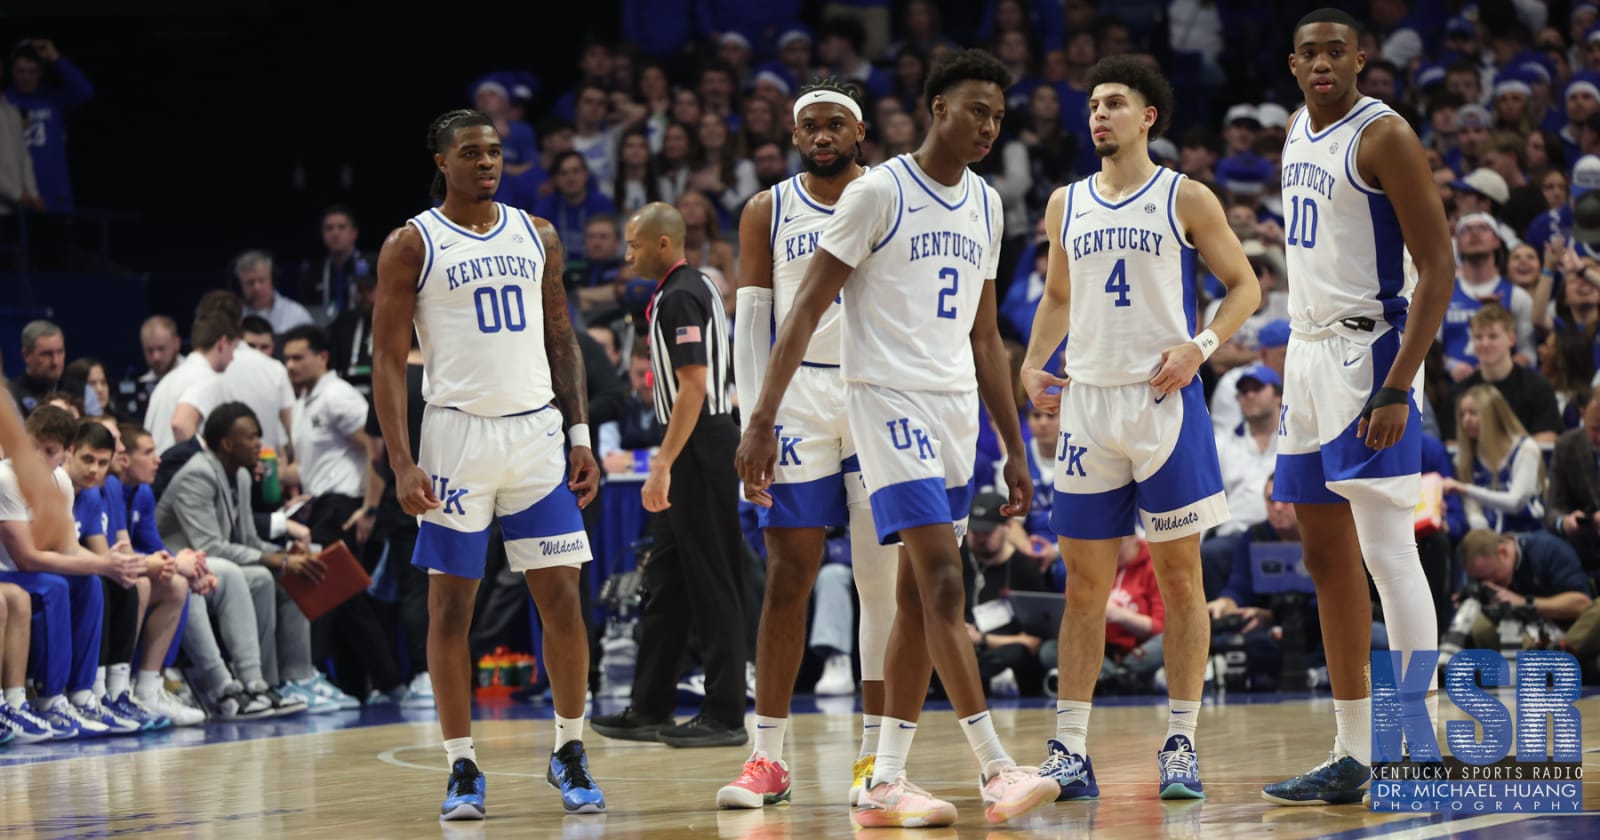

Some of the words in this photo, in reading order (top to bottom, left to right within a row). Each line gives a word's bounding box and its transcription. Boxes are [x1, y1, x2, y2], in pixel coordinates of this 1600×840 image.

[1282, 162, 1335, 200] KENTUCKY
[1288, 195, 1318, 249] 10
[909, 231, 984, 271] KENTUCKY
[1073, 227, 1163, 261] KENTUCKY
[446, 256, 537, 291] KENTUCKY
[937, 267, 959, 319] 2
[1105, 258, 1131, 307] 4
[473, 285, 526, 333] 00
[886, 418, 936, 460] UK
[431, 474, 469, 515] UK
[1152, 511, 1199, 532] Wildcats
[539, 538, 584, 556] Wildcats
